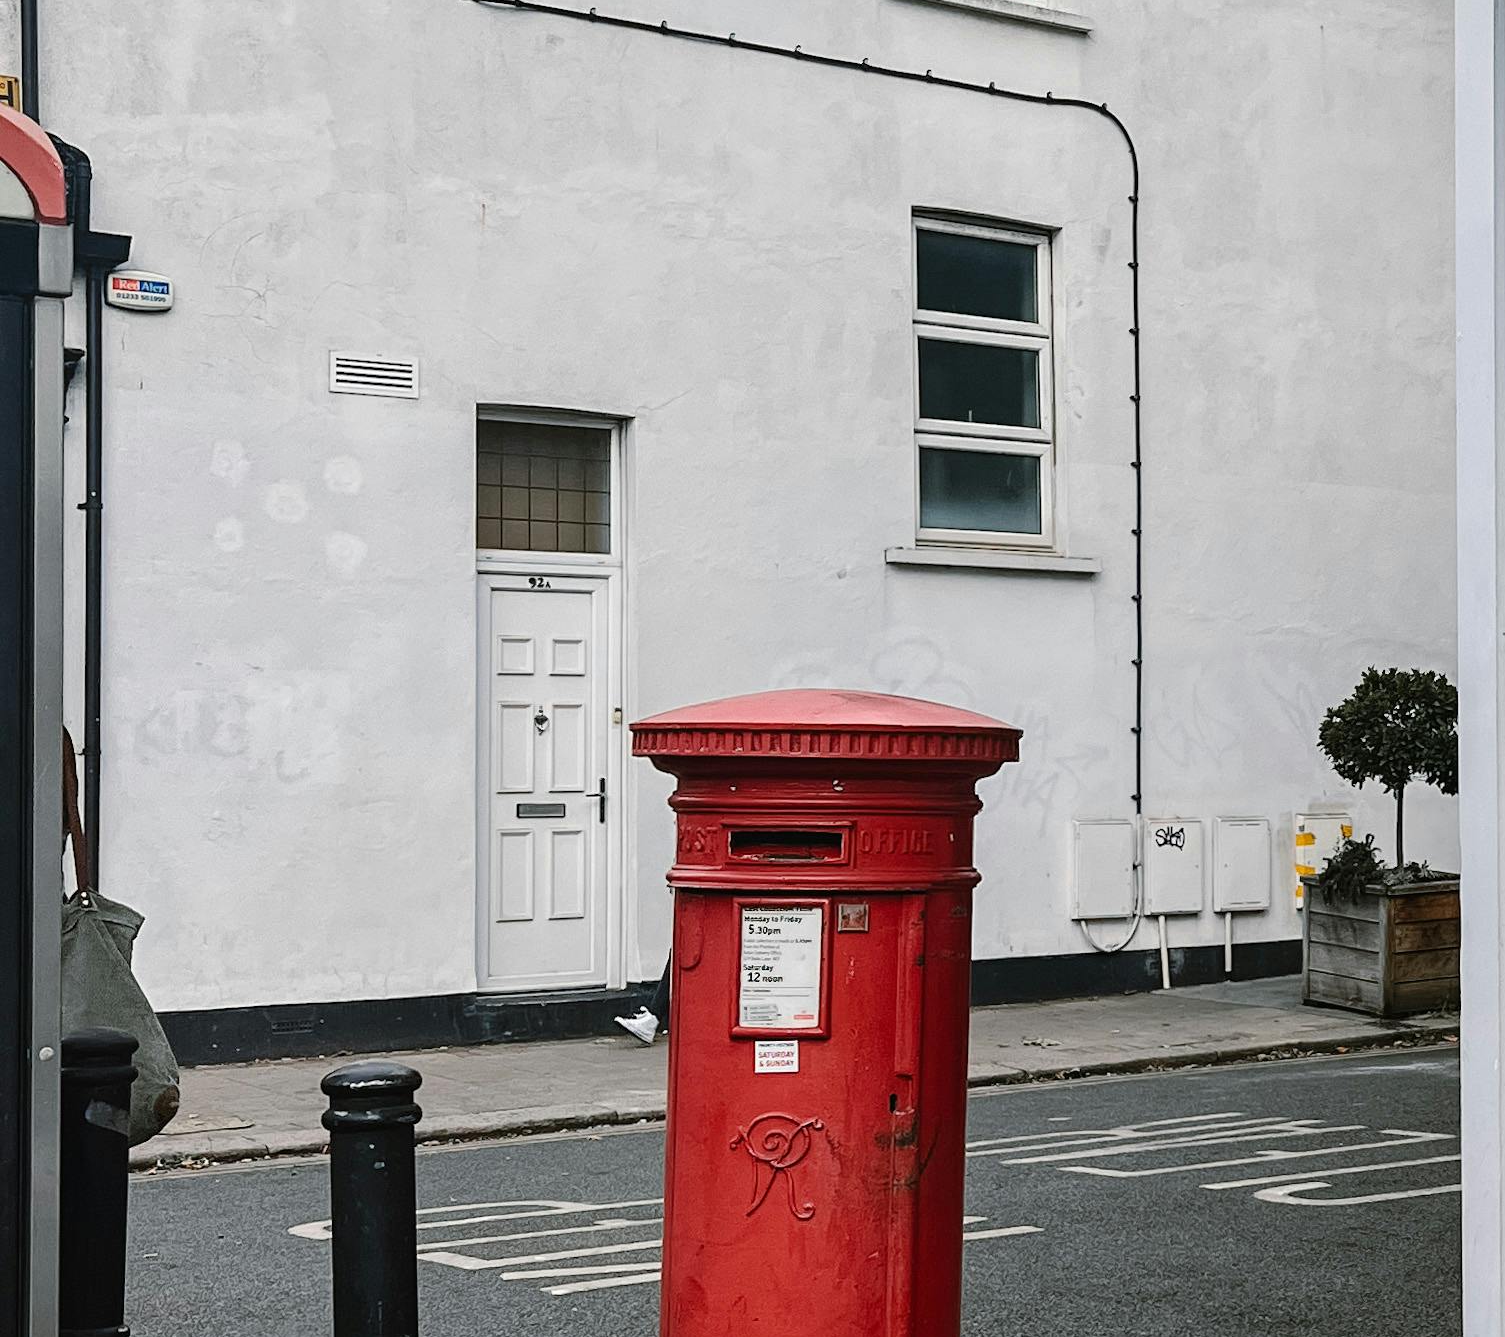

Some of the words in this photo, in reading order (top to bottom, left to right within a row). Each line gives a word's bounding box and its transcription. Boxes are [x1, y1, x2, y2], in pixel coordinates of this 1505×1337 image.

[119, 278, 140, 291] Red
[141, 281, 168, 294] Alert
[858, 827, 935, 855] OFFICE
[743, 964, 774, 973] Saturday
[747, 972, 760, 983] 12
